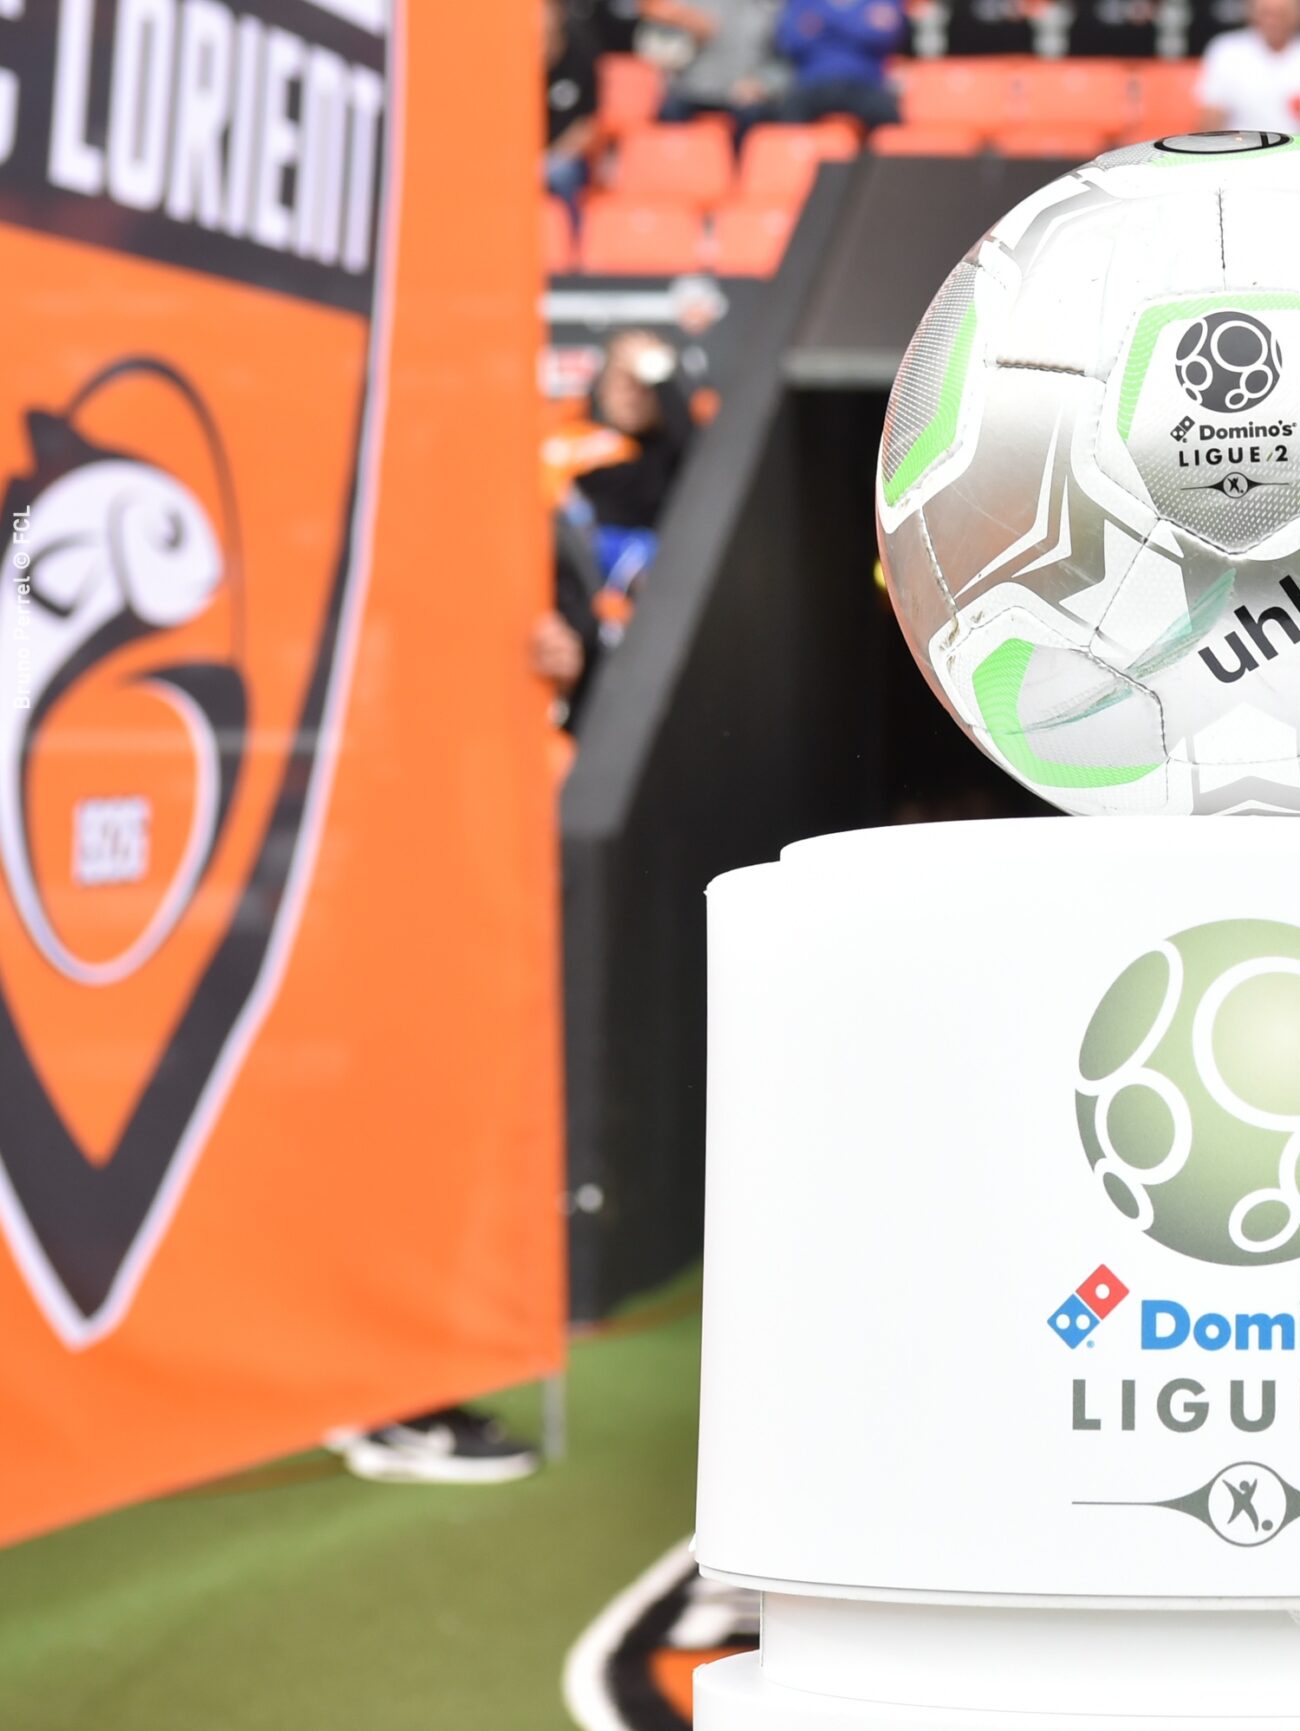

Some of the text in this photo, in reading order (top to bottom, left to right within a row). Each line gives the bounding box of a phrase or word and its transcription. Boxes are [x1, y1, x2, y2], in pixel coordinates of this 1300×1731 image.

[47, 0, 383, 275] LORIENT
[1199, 420, 1294, 441] Domino's
[1179, 445, 1288, 467] LIGUE 2
